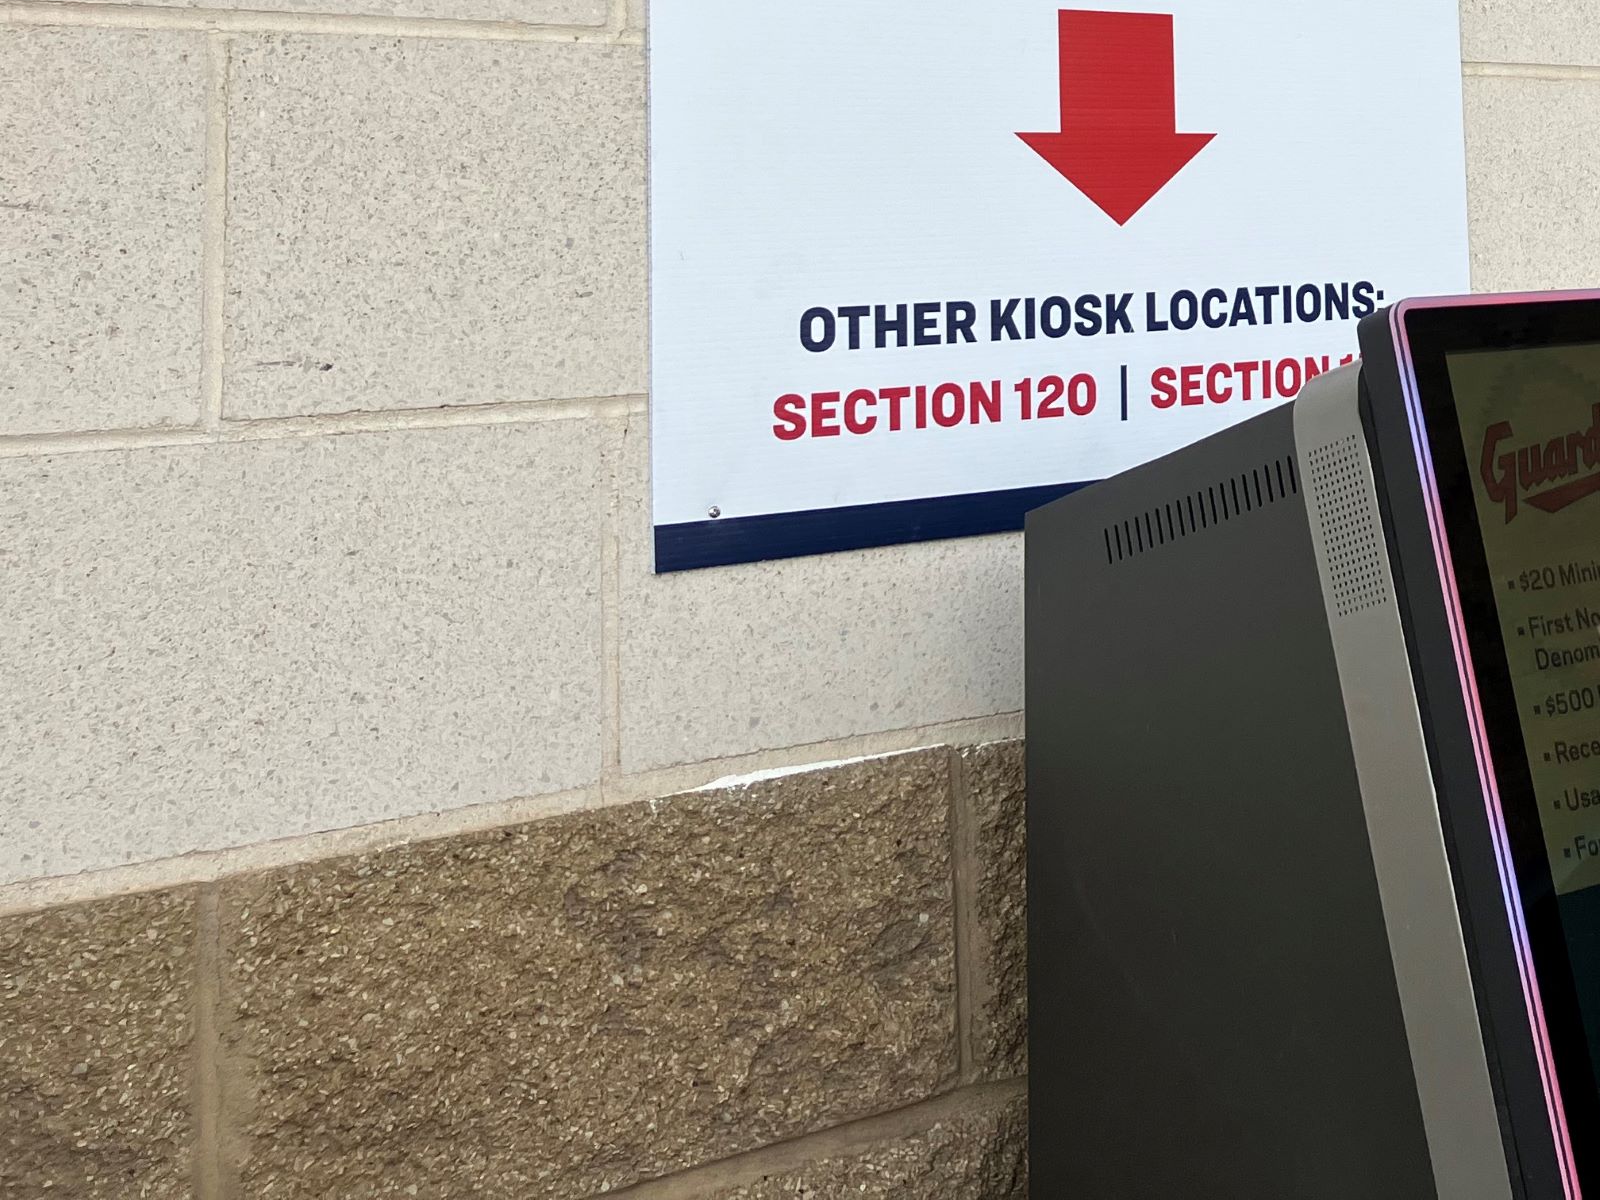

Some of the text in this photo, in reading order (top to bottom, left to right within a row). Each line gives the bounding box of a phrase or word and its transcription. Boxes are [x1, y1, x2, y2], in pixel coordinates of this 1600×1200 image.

[799, 300, 978, 353] OTHER
[990, 292, 1135, 342] KIOSK
[772, 355, 1330, 441] SECTION 120 SECTION
[1519, 568, 1555, 593] $20
[1527, 612, 1578, 639] First
[1546, 687, 1594, 716] $500
